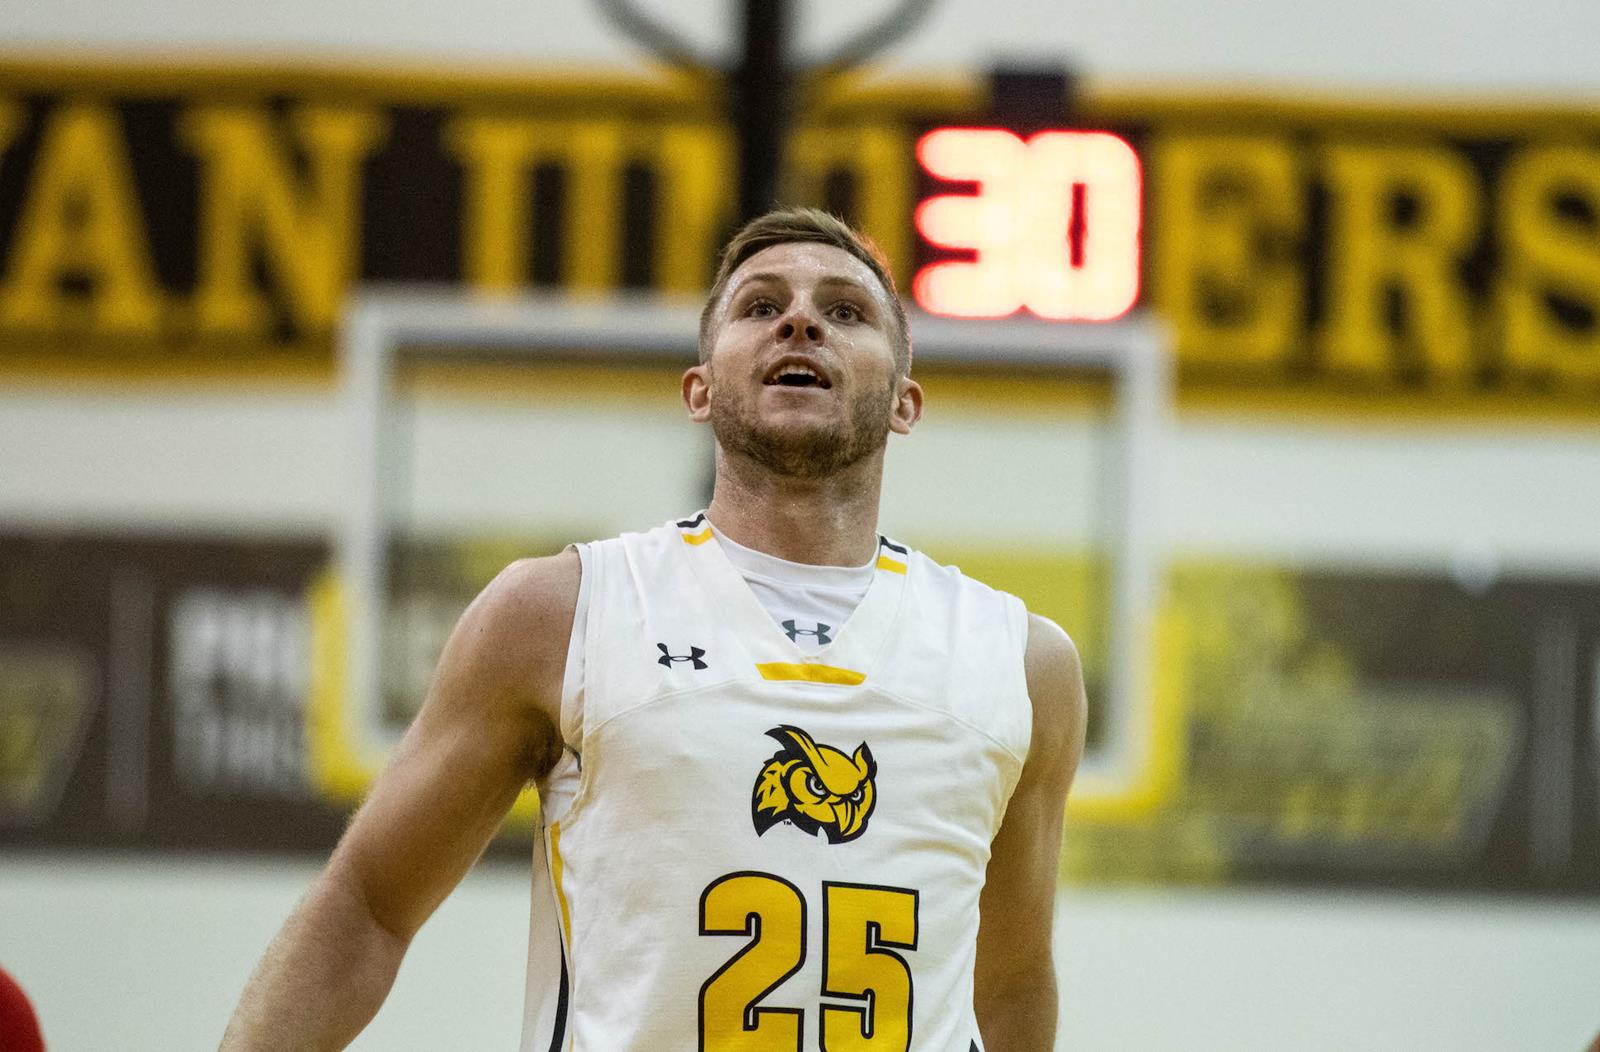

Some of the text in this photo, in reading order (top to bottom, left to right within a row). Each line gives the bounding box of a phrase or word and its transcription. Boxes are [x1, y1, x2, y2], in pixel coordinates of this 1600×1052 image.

[0, 104, 390, 331] AN
[914, 127, 1142, 321] 30
[698, 870, 919, 1052] 25
